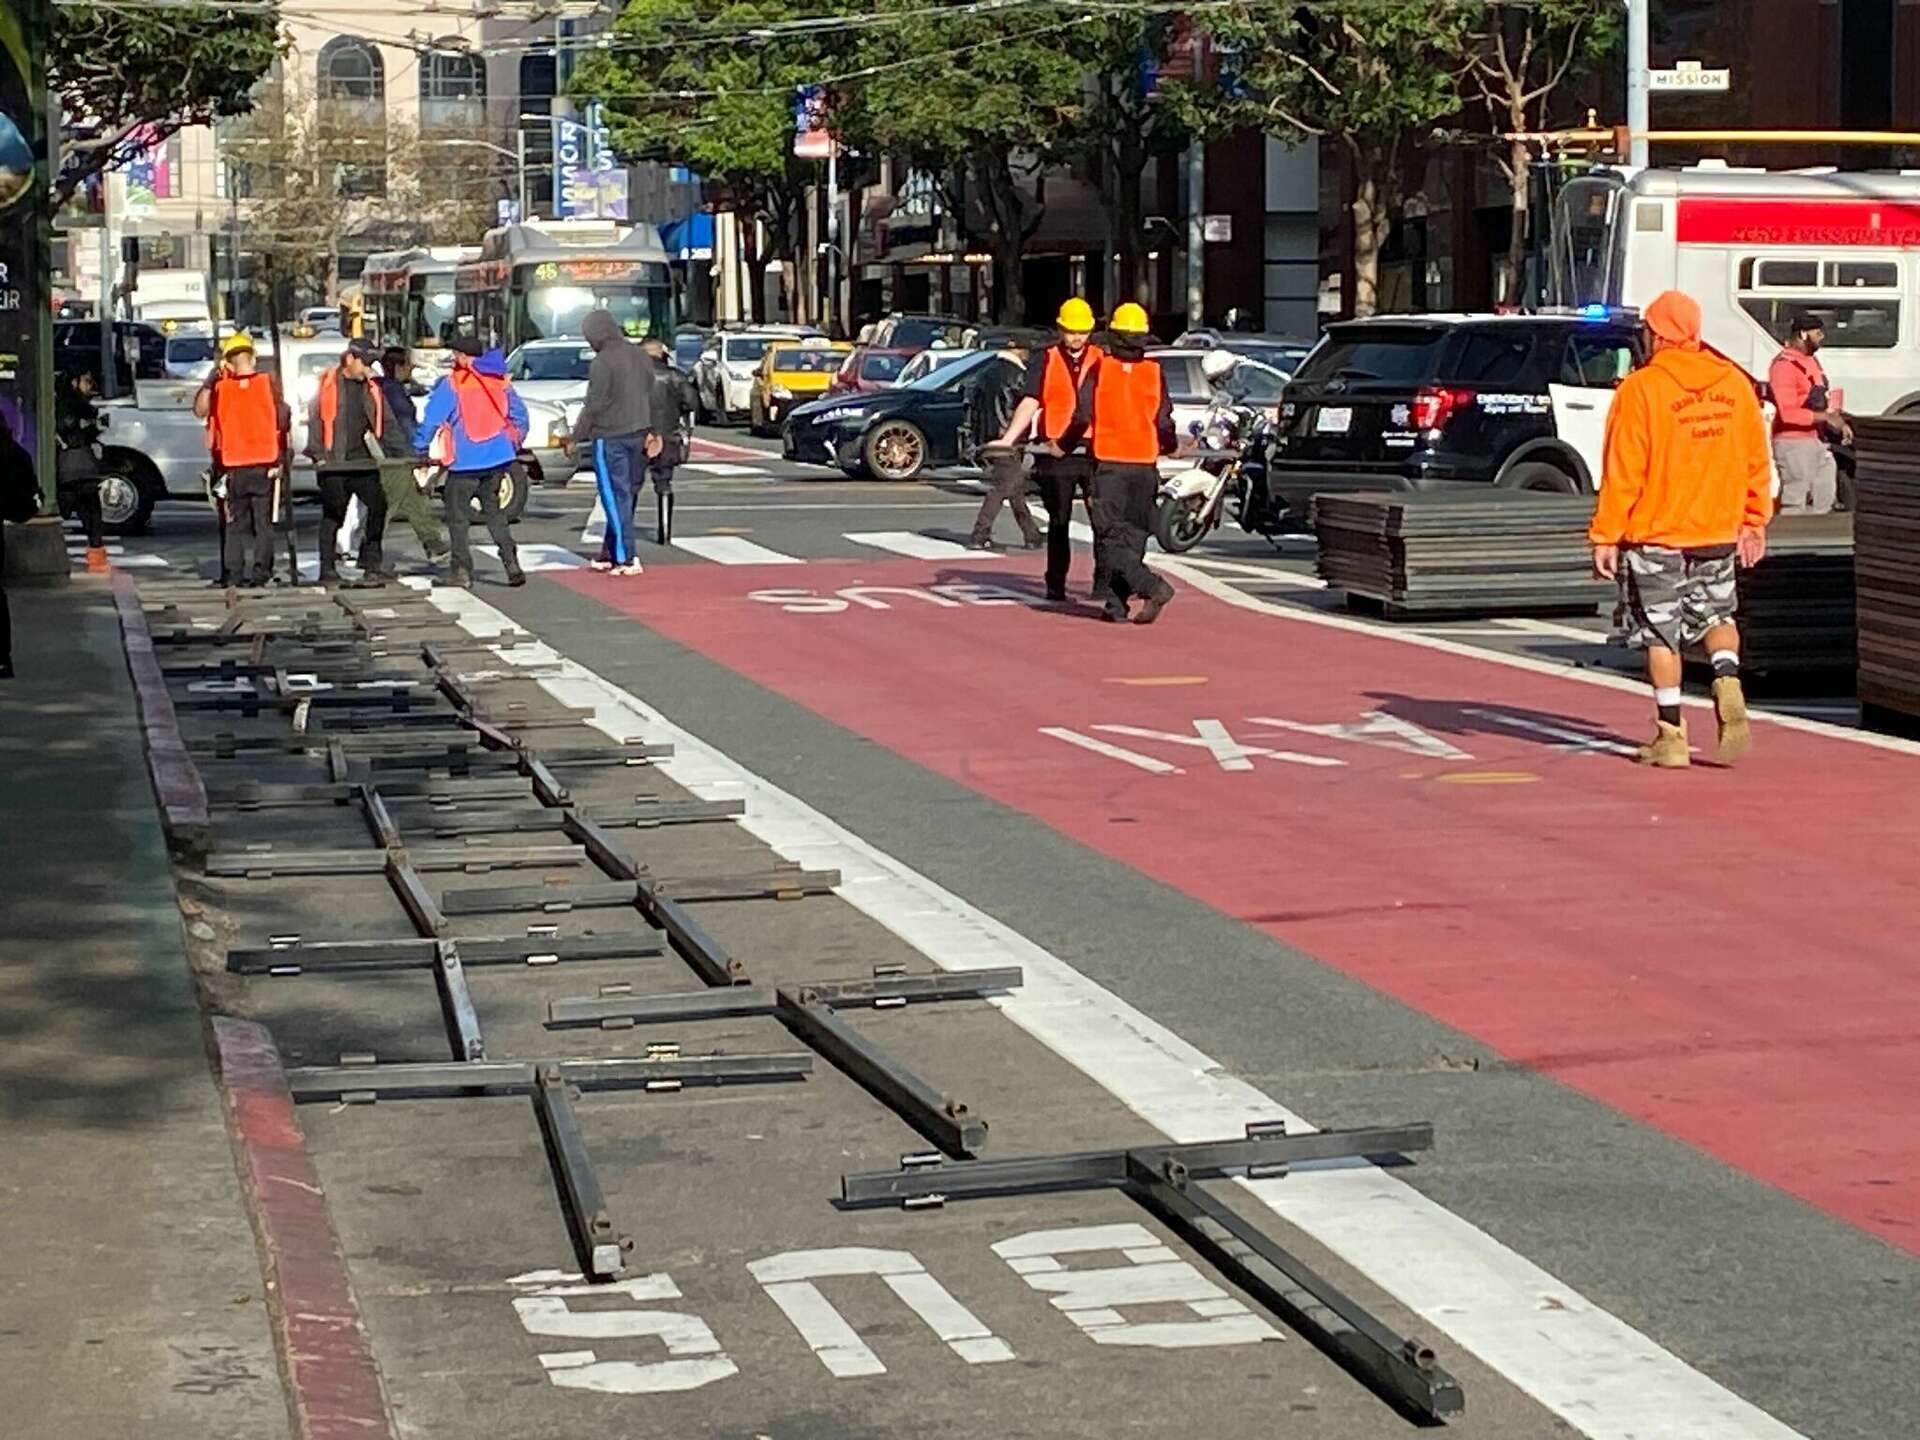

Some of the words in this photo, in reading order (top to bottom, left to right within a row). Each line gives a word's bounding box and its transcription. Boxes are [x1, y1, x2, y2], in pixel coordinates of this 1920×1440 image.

[1656, 74, 1721, 85] MISSION
[560, 121, 579, 208] ROSS
[748, 585, 1060, 613] BUS
[1037, 706, 1700, 773] TAXI
[504, 1222, 1287, 1394] BUS
